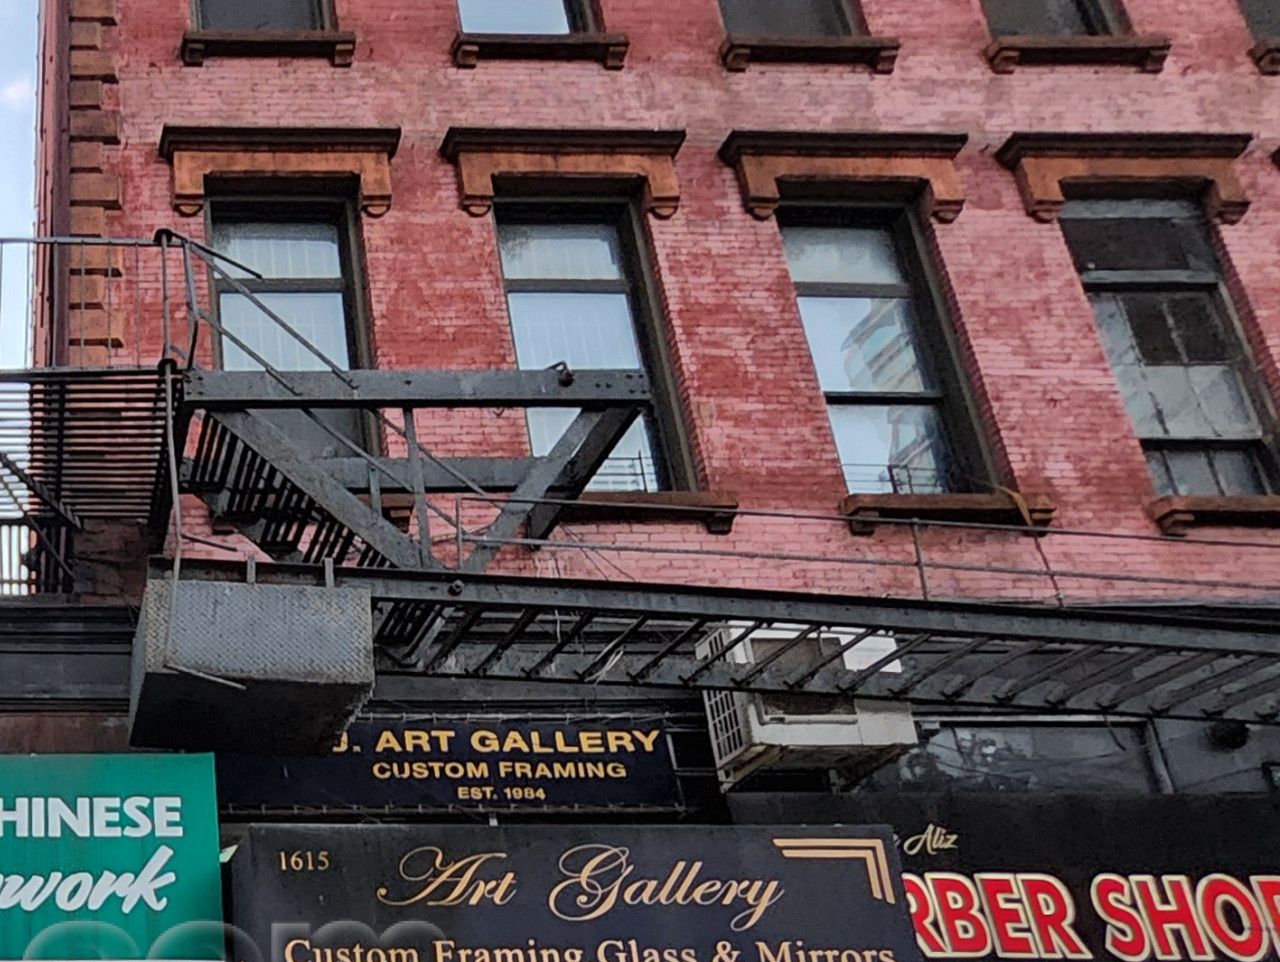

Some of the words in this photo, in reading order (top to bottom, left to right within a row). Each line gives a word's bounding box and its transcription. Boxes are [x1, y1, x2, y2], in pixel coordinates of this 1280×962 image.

[375, 730, 456, 752] ART
[470, 730, 662, 753] GALLERY
[372, 761, 489, 779] CUSTOM
[499, 761, 628, 779] FRAMING
[457, 786, 498, 800] EST.
[503, 786, 546, 801] 1984
[278, 850, 330, 872] 1615
[377, 844, 518, 908] Art
[548, 842, 786, 932] Gallery
